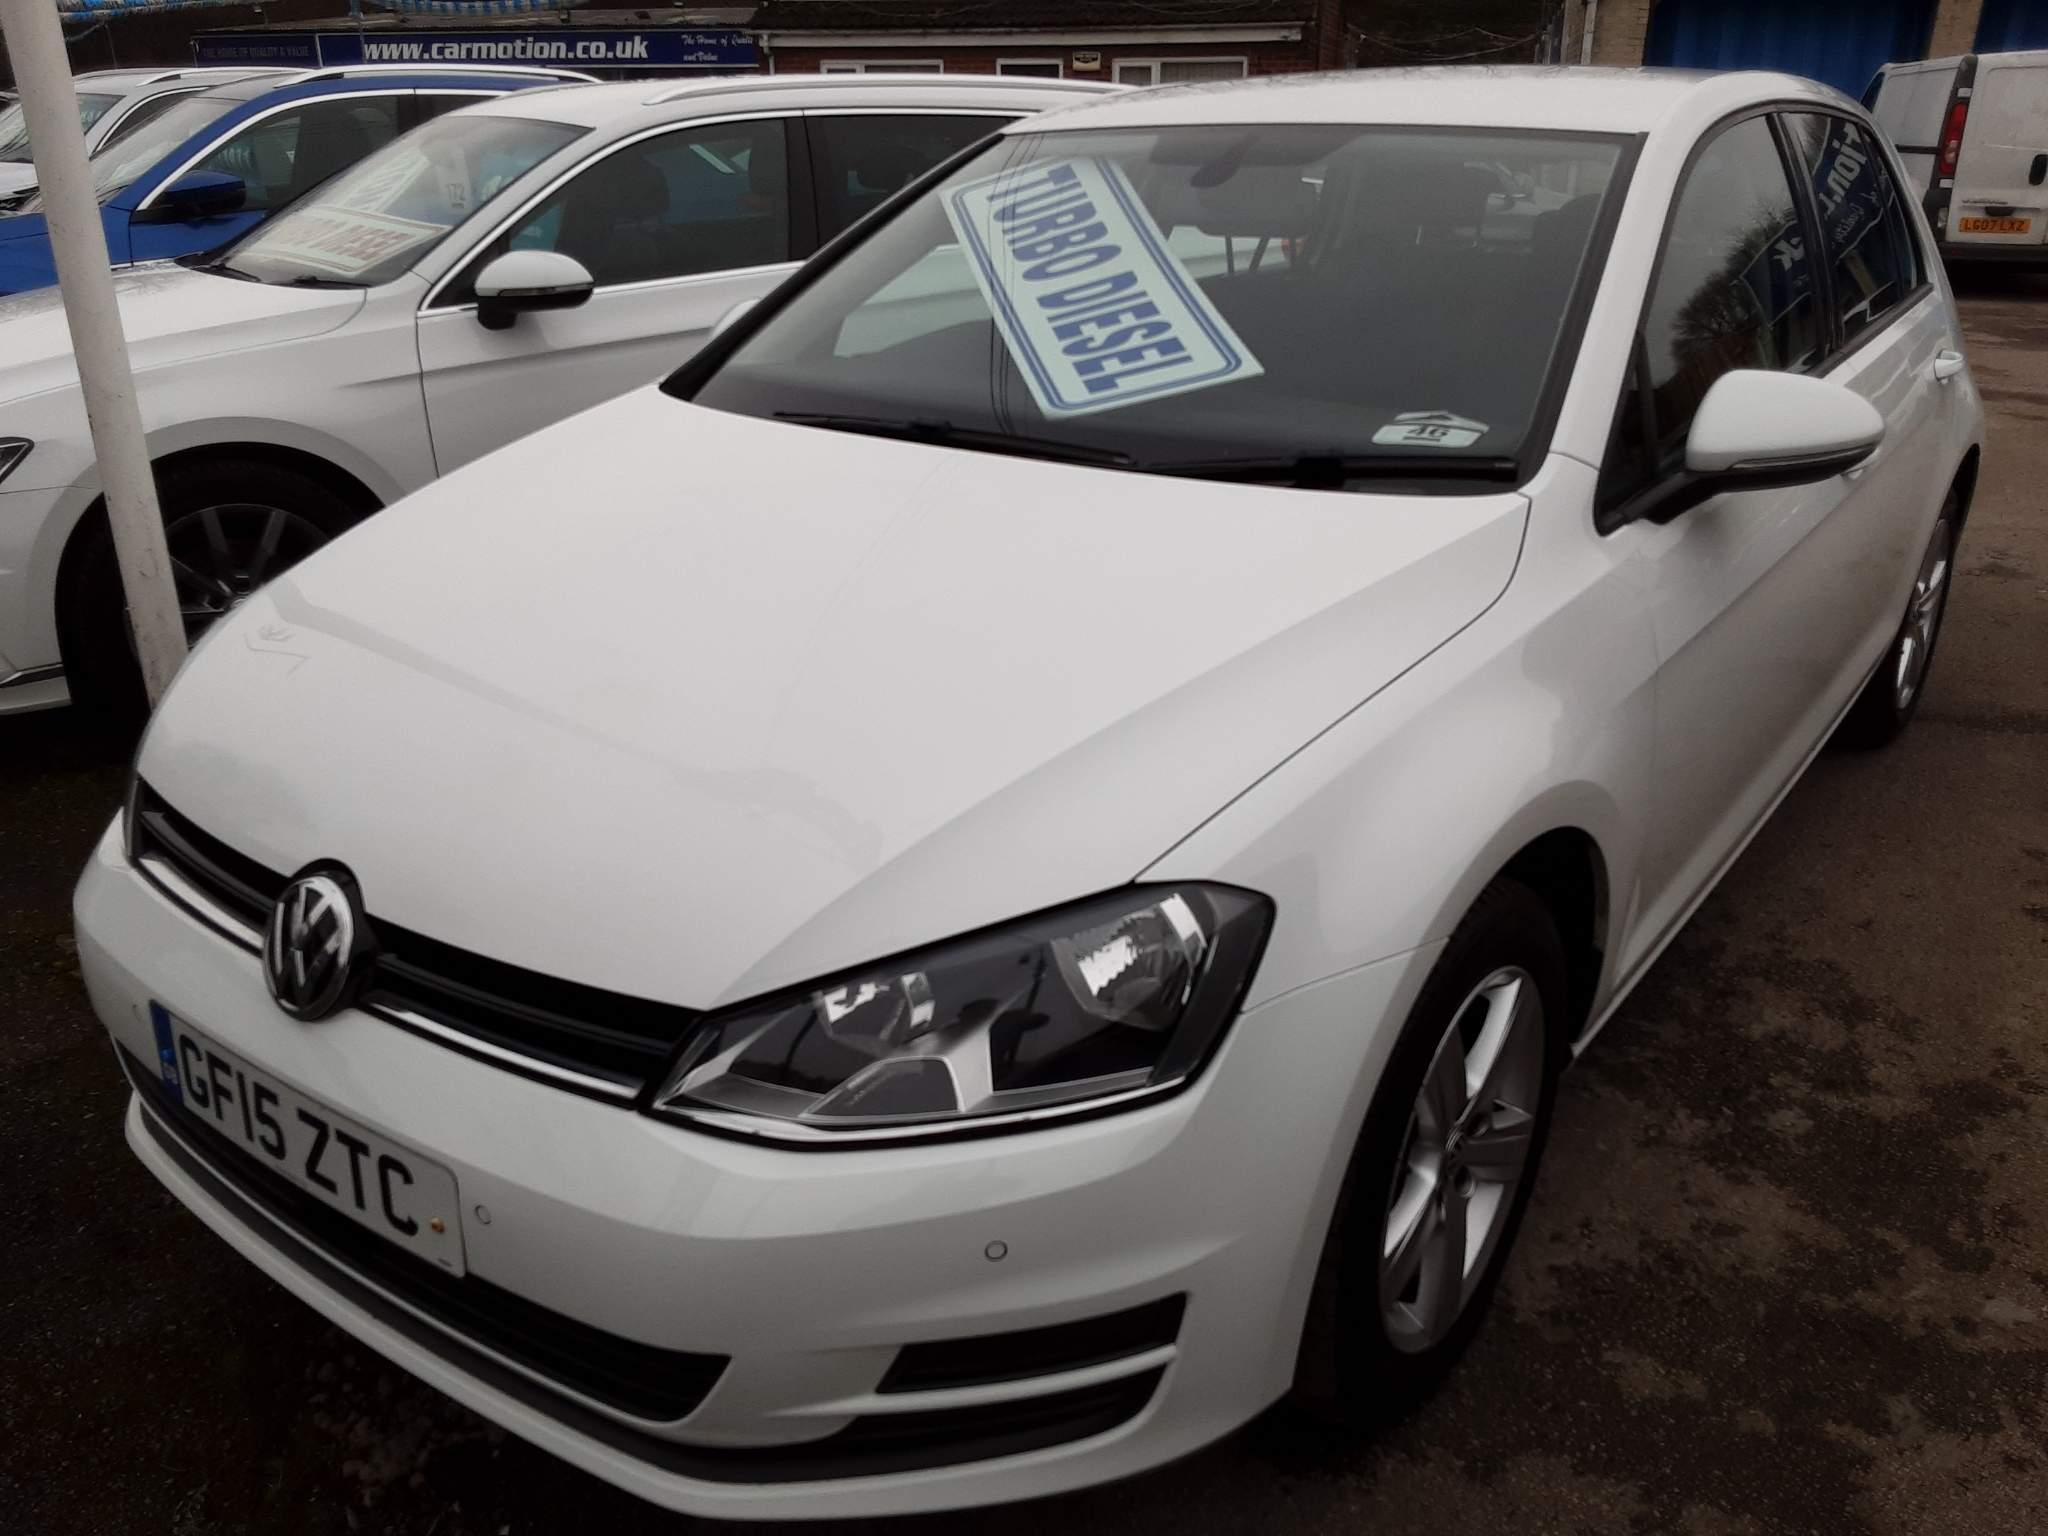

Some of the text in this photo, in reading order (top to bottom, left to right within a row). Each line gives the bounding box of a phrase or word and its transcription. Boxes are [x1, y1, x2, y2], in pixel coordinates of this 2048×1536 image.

[364, 36, 649, 60] www.carmotion.co.uk
[986, 163, 1194, 395] TURBO DIESEL
[1963, 219, 2025, 231] LG07 LXZ
[179, 1033, 420, 1237] GF15 ZTC
